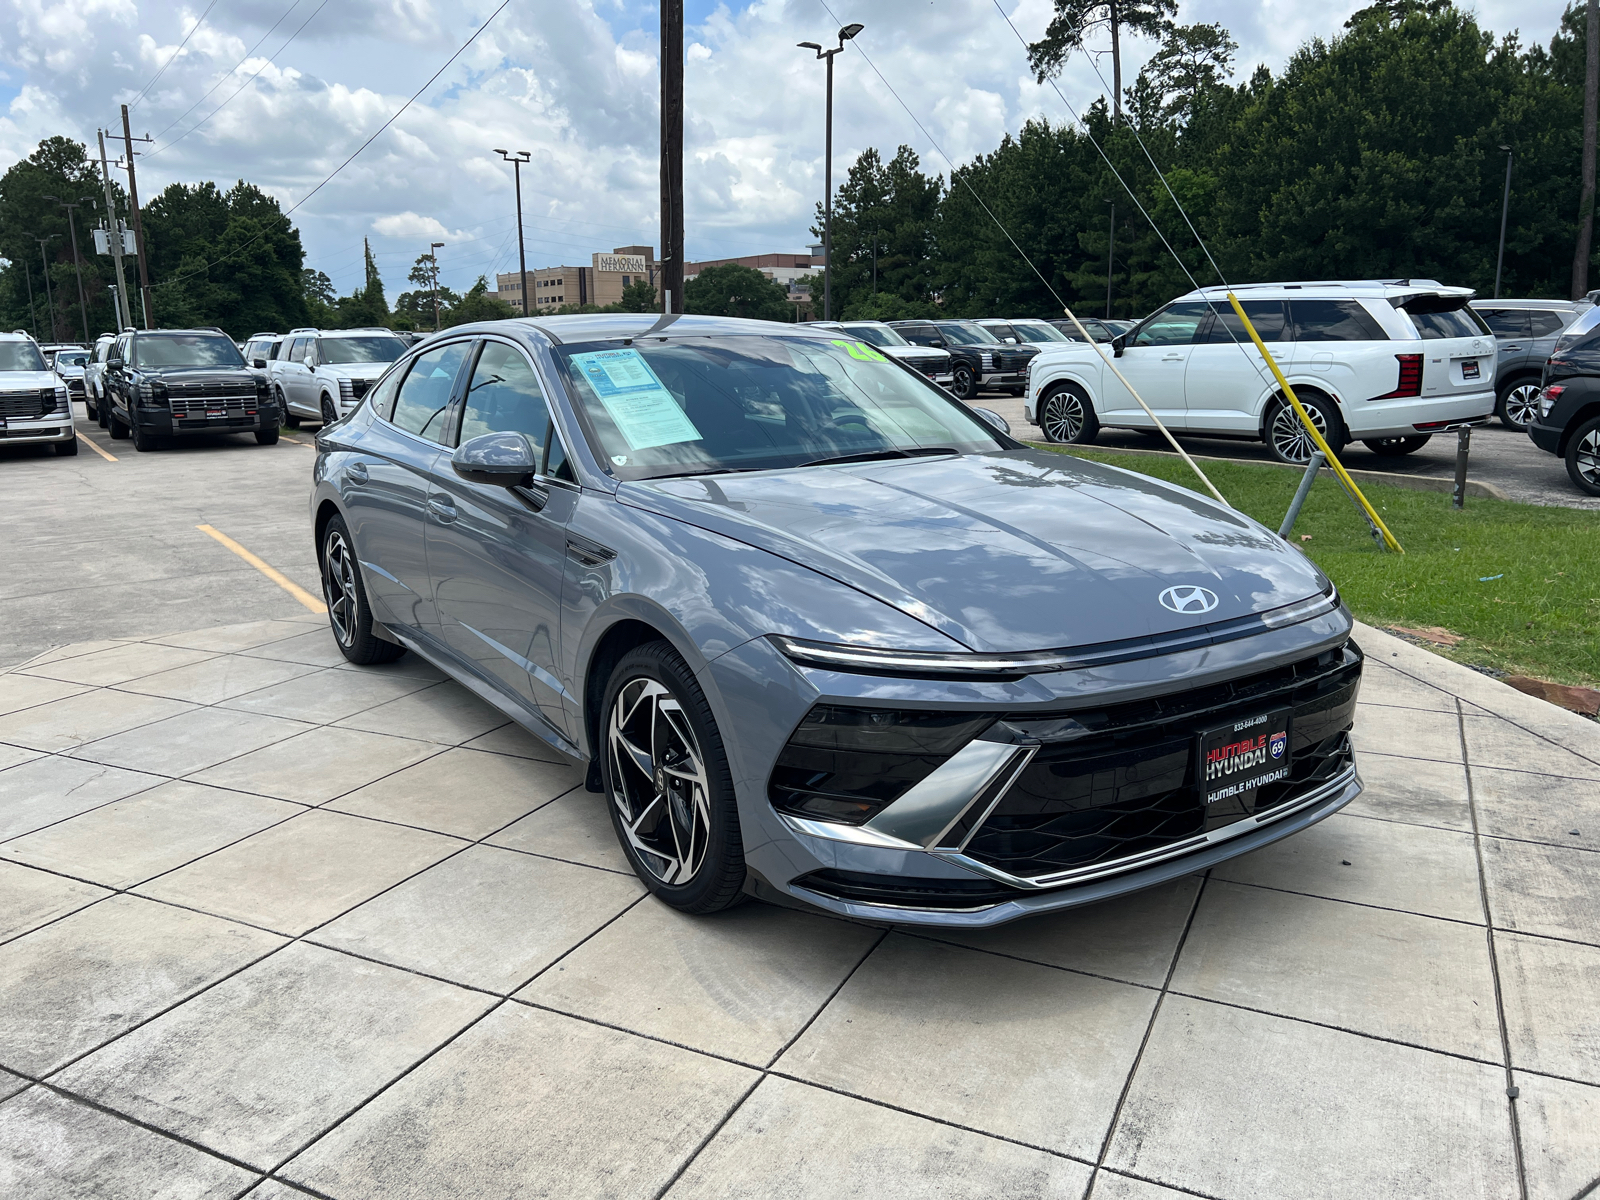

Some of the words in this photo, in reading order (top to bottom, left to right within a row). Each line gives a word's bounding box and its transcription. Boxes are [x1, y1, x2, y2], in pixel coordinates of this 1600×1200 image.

[601, 257, 642, 266] MEMORIAL
[601, 263, 644, 271] HERMANN
[830, 340, 890, 363] 26
[1233, 714, 1268, 732] 832-644-4000
[1206, 734, 1267, 764] HUMBLE
[1272, 741, 1284, 755] 69
[1206, 747, 1266, 781] HYUNDAI
[1207, 782, 1245, 804] HUMBLE
[1245, 769, 1283, 790] HYUNDAI
